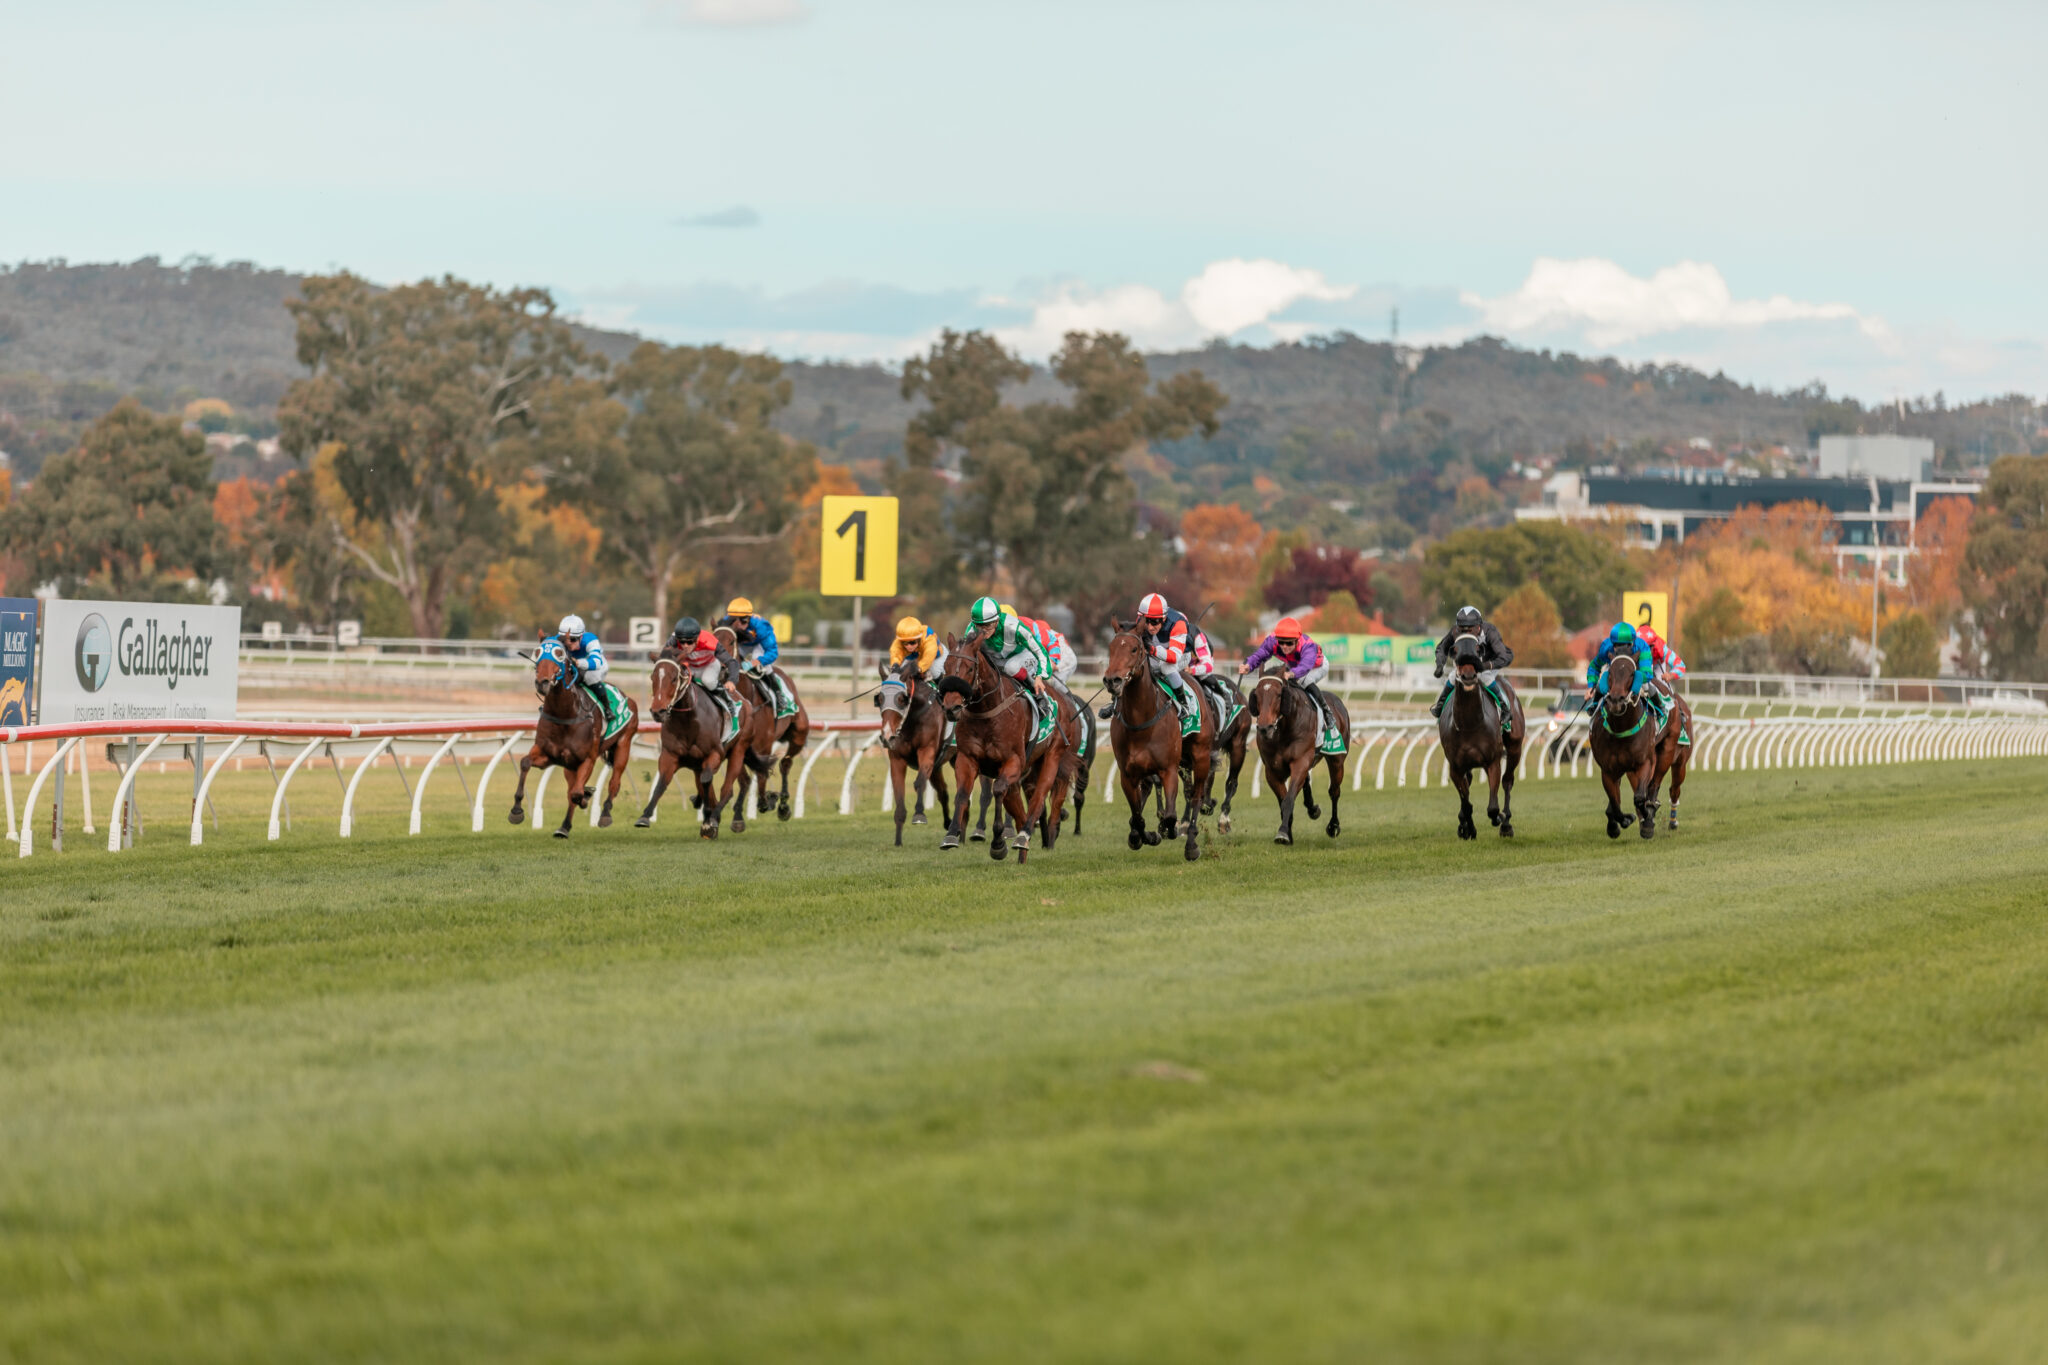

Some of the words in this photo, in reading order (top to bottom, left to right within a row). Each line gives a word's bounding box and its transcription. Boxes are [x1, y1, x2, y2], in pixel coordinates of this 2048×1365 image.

[836, 510, 867, 581] 1
[4, 631, 28, 652] MAGIC
[636, 622, 655, 644] 2
[3, 653, 26, 667] MILLIONS
[117, 617, 212, 690] Gallagher
[74, 704, 105, 721] Insurance
[113, 702, 126, 720] Risk
[127, 704, 167, 720] Management
[175, 703, 207, 720] Consulting
